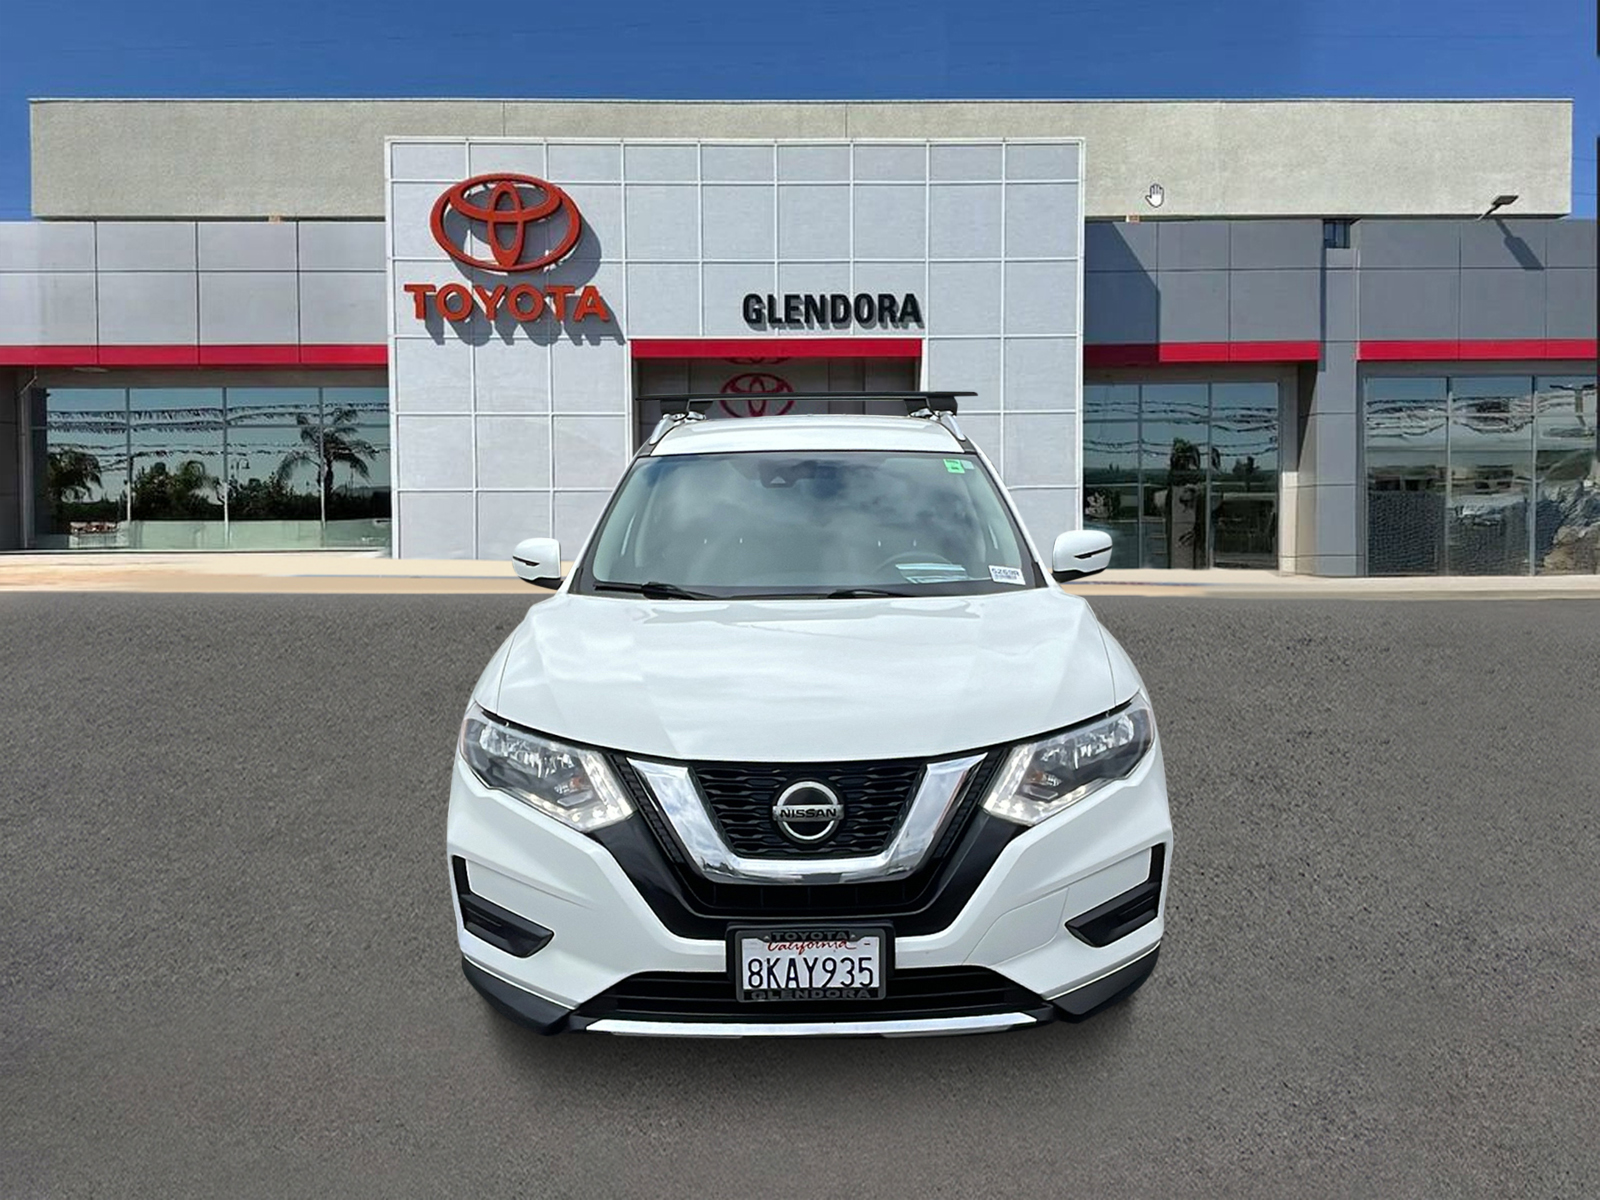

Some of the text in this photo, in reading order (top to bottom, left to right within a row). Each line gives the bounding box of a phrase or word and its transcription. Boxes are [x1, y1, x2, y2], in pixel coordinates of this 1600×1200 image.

[404, 284, 610, 322] TOYOTA
[742, 293, 924, 325] GLENDORA
[780, 808, 836, 818] NISSAN
[772, 931, 849, 941] TOYOTA
[747, 957, 873, 989] 8KAY935
[751, 989, 871, 999] GLENDORA
